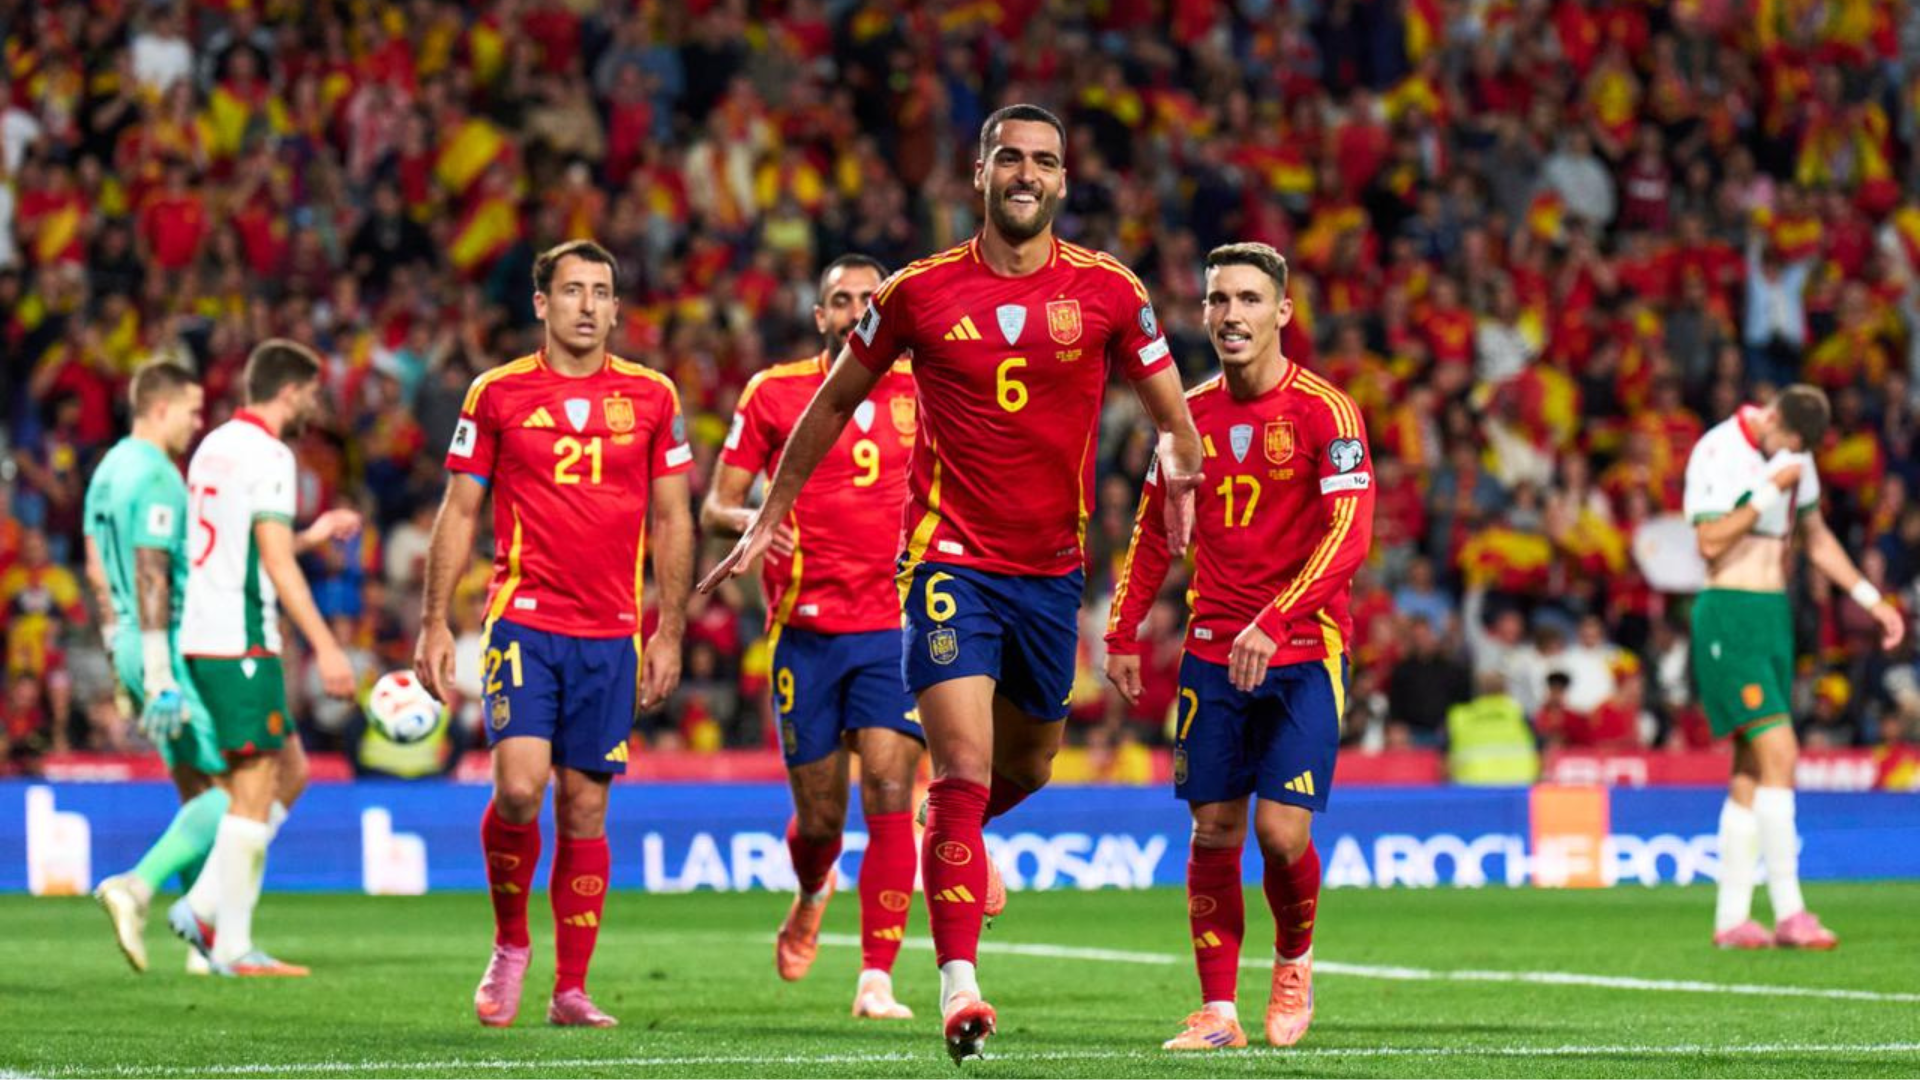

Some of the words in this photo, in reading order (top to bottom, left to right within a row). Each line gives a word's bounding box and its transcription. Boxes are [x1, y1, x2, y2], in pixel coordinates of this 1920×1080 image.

[996, 357, 1028, 412] 6
[553, 435, 602, 484] 21
[853, 439, 880, 487] 9
[187, 484, 218, 567] 5
[1216, 475, 1261, 528] 17
[925, 571, 957, 622] 6
[485, 641, 523, 694] 21
[777, 667, 795, 713] 9
[1180, 687, 1199, 740] 7
